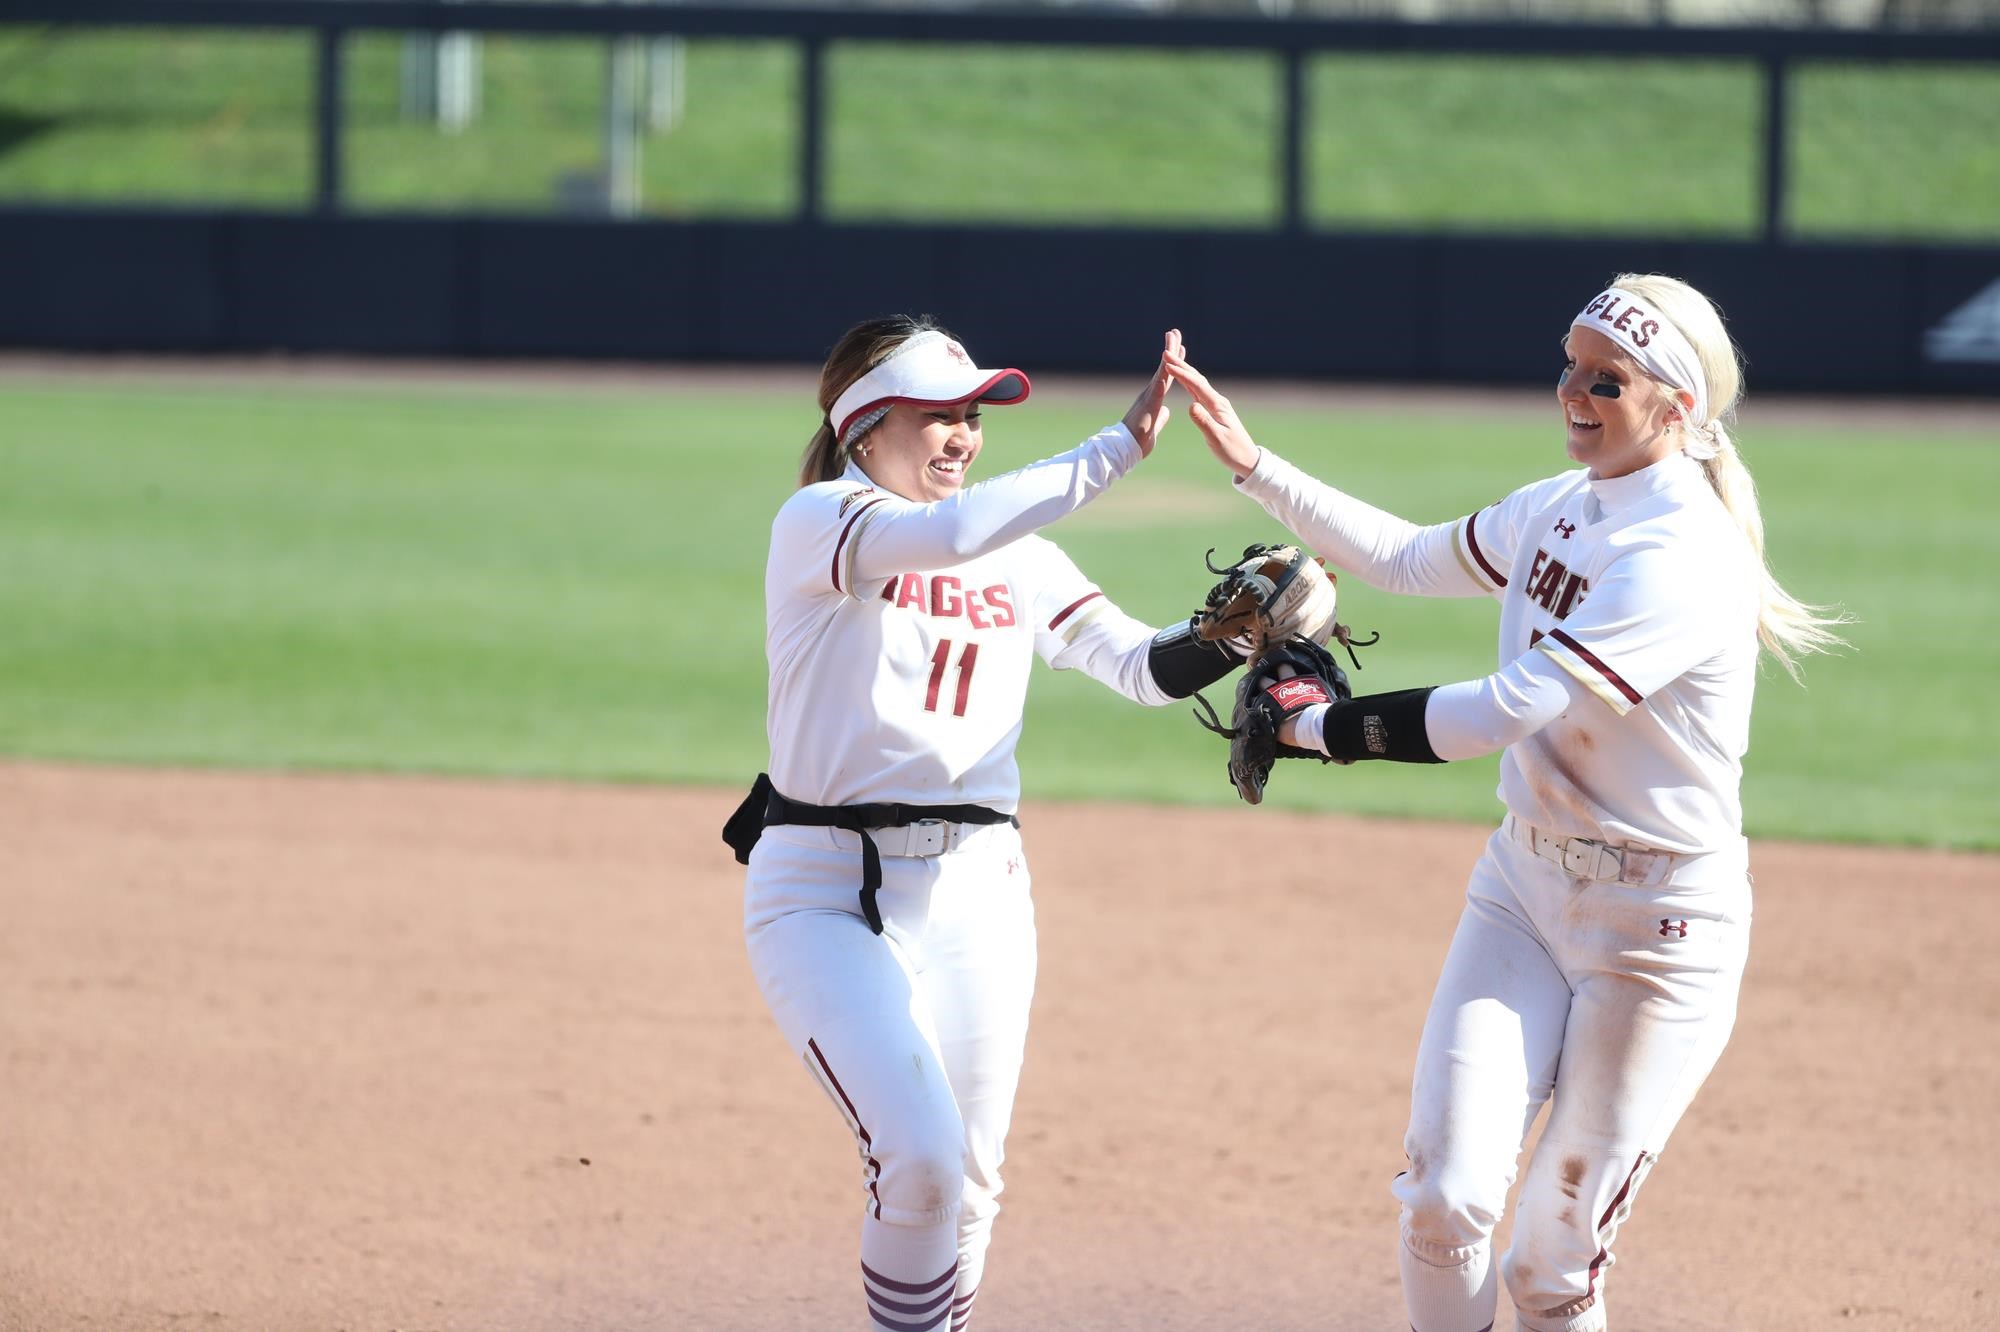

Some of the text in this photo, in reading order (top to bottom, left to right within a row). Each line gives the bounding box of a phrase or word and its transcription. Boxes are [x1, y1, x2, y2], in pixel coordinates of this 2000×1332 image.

[1579, 294, 1660, 348] GLES
[882, 572, 1016, 630] AGES
[923, 638, 980, 718] 11
